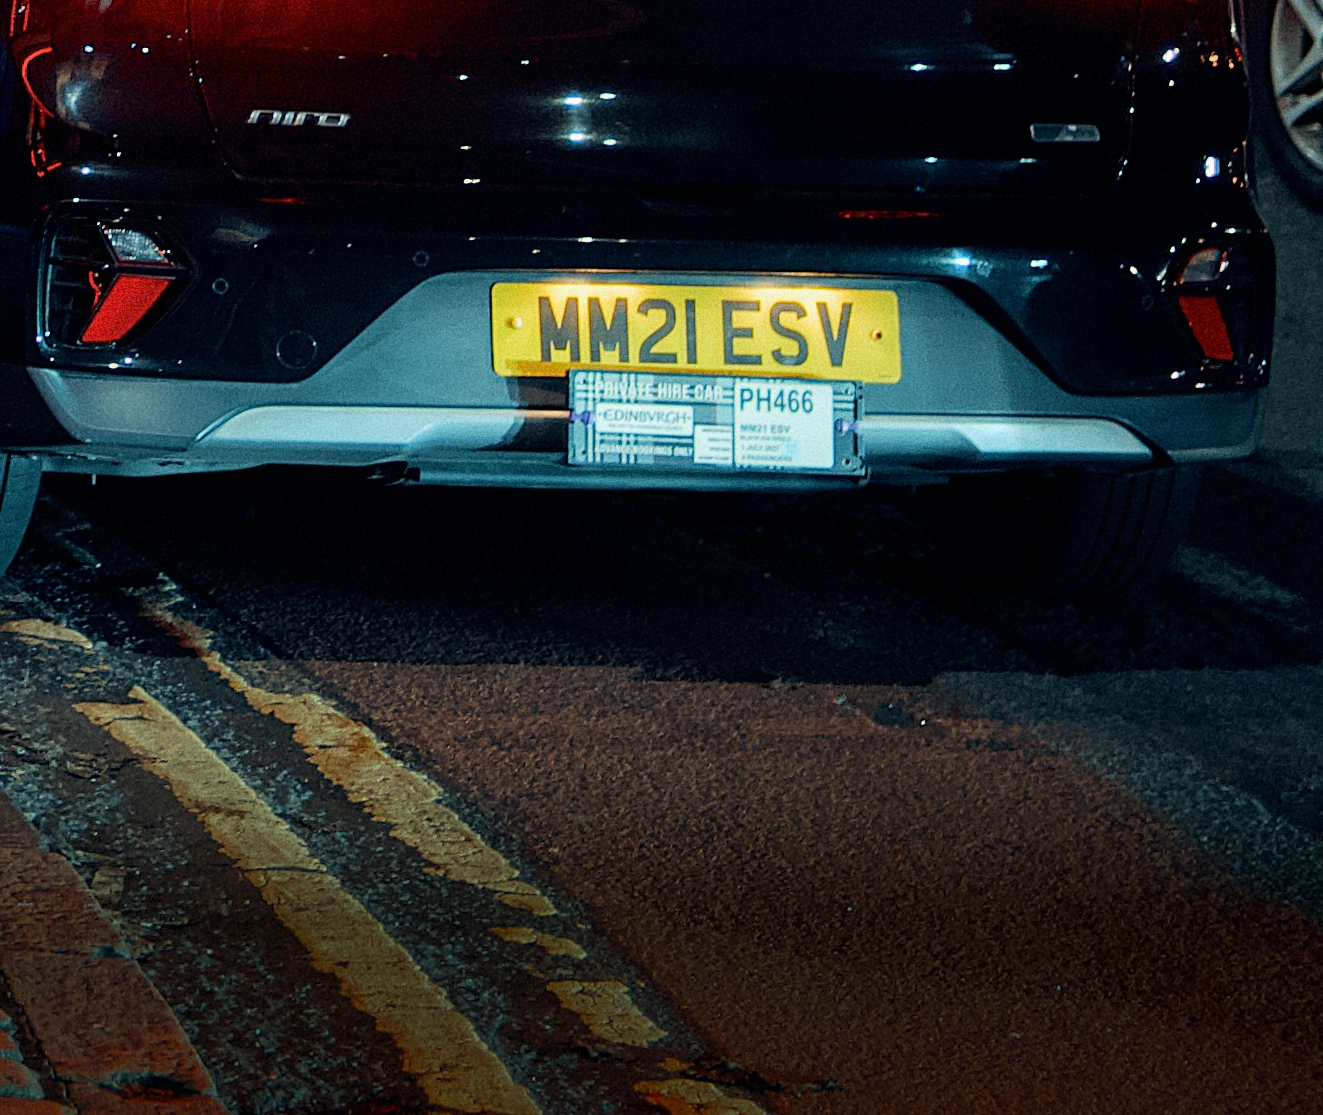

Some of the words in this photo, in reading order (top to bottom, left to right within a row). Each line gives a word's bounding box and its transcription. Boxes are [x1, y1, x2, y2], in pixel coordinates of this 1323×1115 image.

[538, 296, 697, 365] MM21
[722, 300, 854, 367] ESV
[595, 381, 652, 399] PRIVATE
[657, 383, 692, 400] HIRE
[694, 384, 724, 401] CAR
[740, 388, 814, 414] PH466
